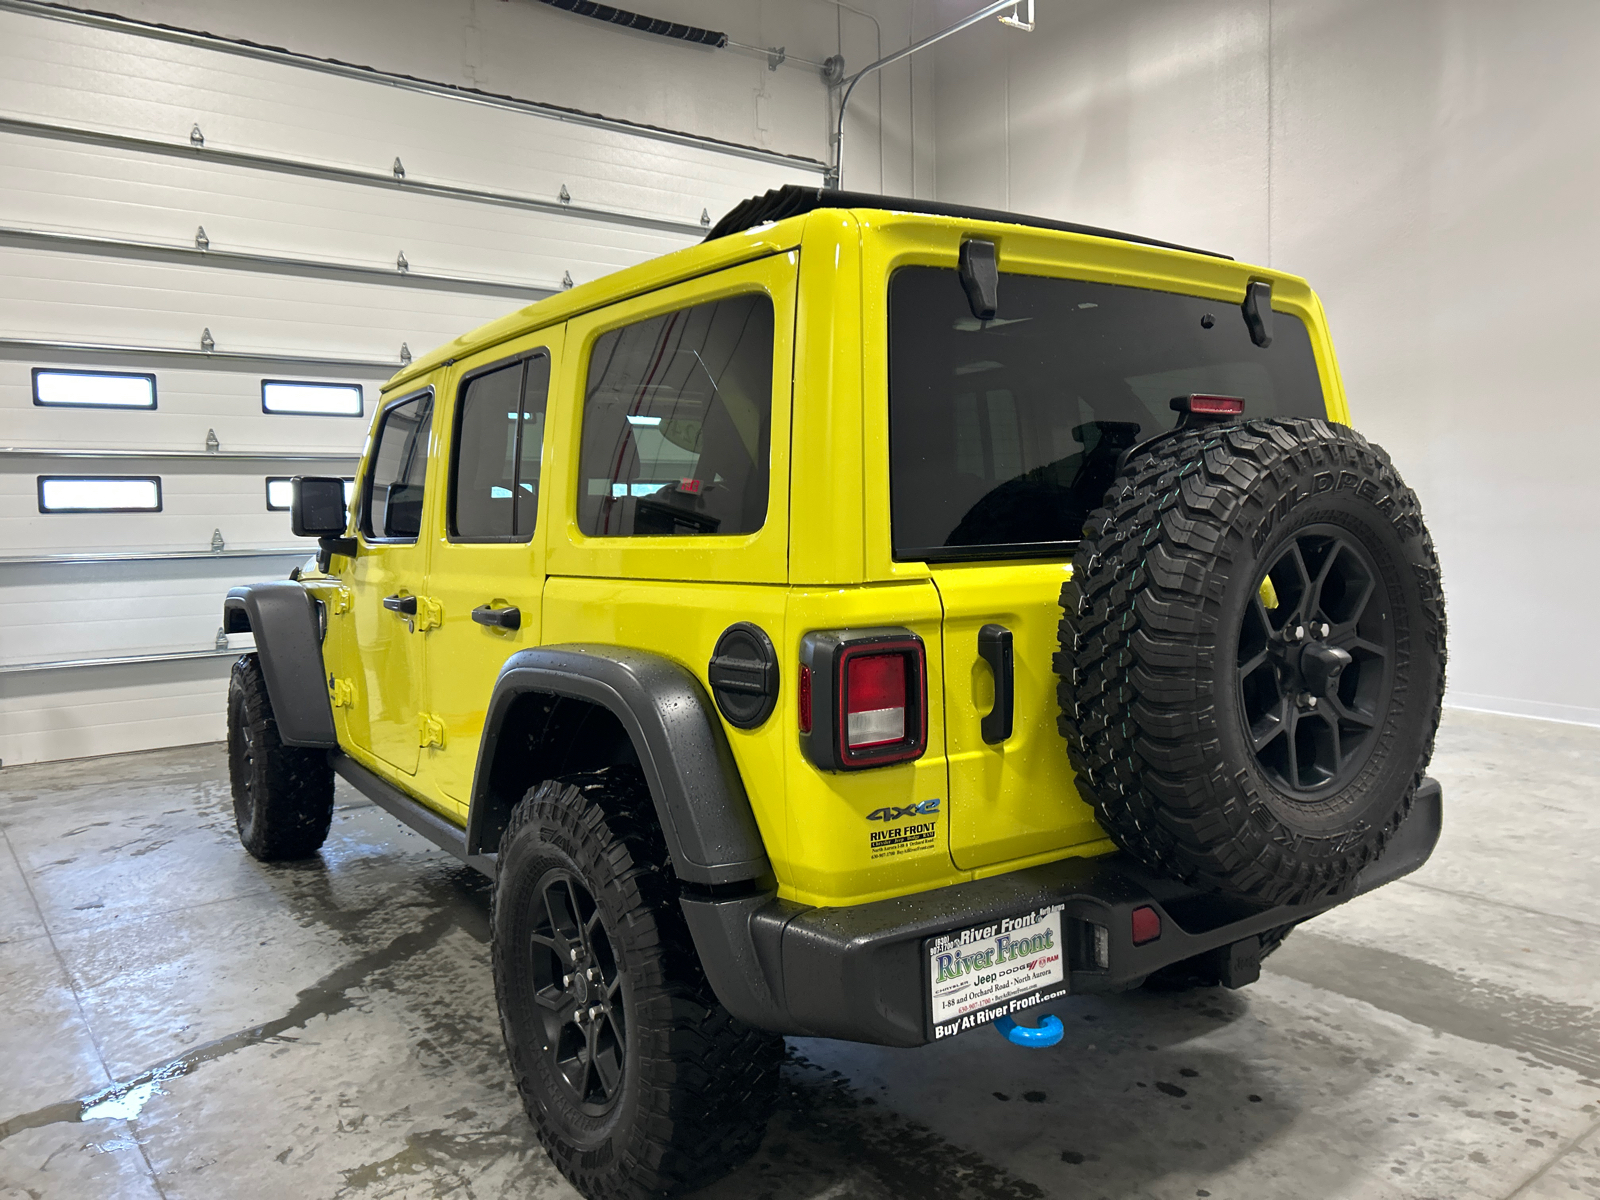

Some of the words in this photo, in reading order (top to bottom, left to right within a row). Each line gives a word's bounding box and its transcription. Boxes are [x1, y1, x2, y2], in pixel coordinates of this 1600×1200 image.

[1251, 470, 1417, 559] WILDPEAK
[870, 828, 901, 841] RIVER
[904, 822, 935, 835] FRONT
[960, 924, 997, 945] River
[1001, 912, 1036, 932] Front
[936, 949, 995, 984] River
[995, 928, 1054, 965] Front
[973, 972, 997, 987] Jeep
[1046, 954, 1059, 963] RAM
[956, 993, 968, 1005] and
[968, 984, 994, 1001] Orchard
[994, 980, 1010, 992] Road
[1013, 973, 1031, 986] North
[1031, 969, 1051, 980] Aurora
[935, 1019, 961, 1039] Buy
[961, 1015, 976, 1029] At
[976, 1006, 1008, 1024] River
